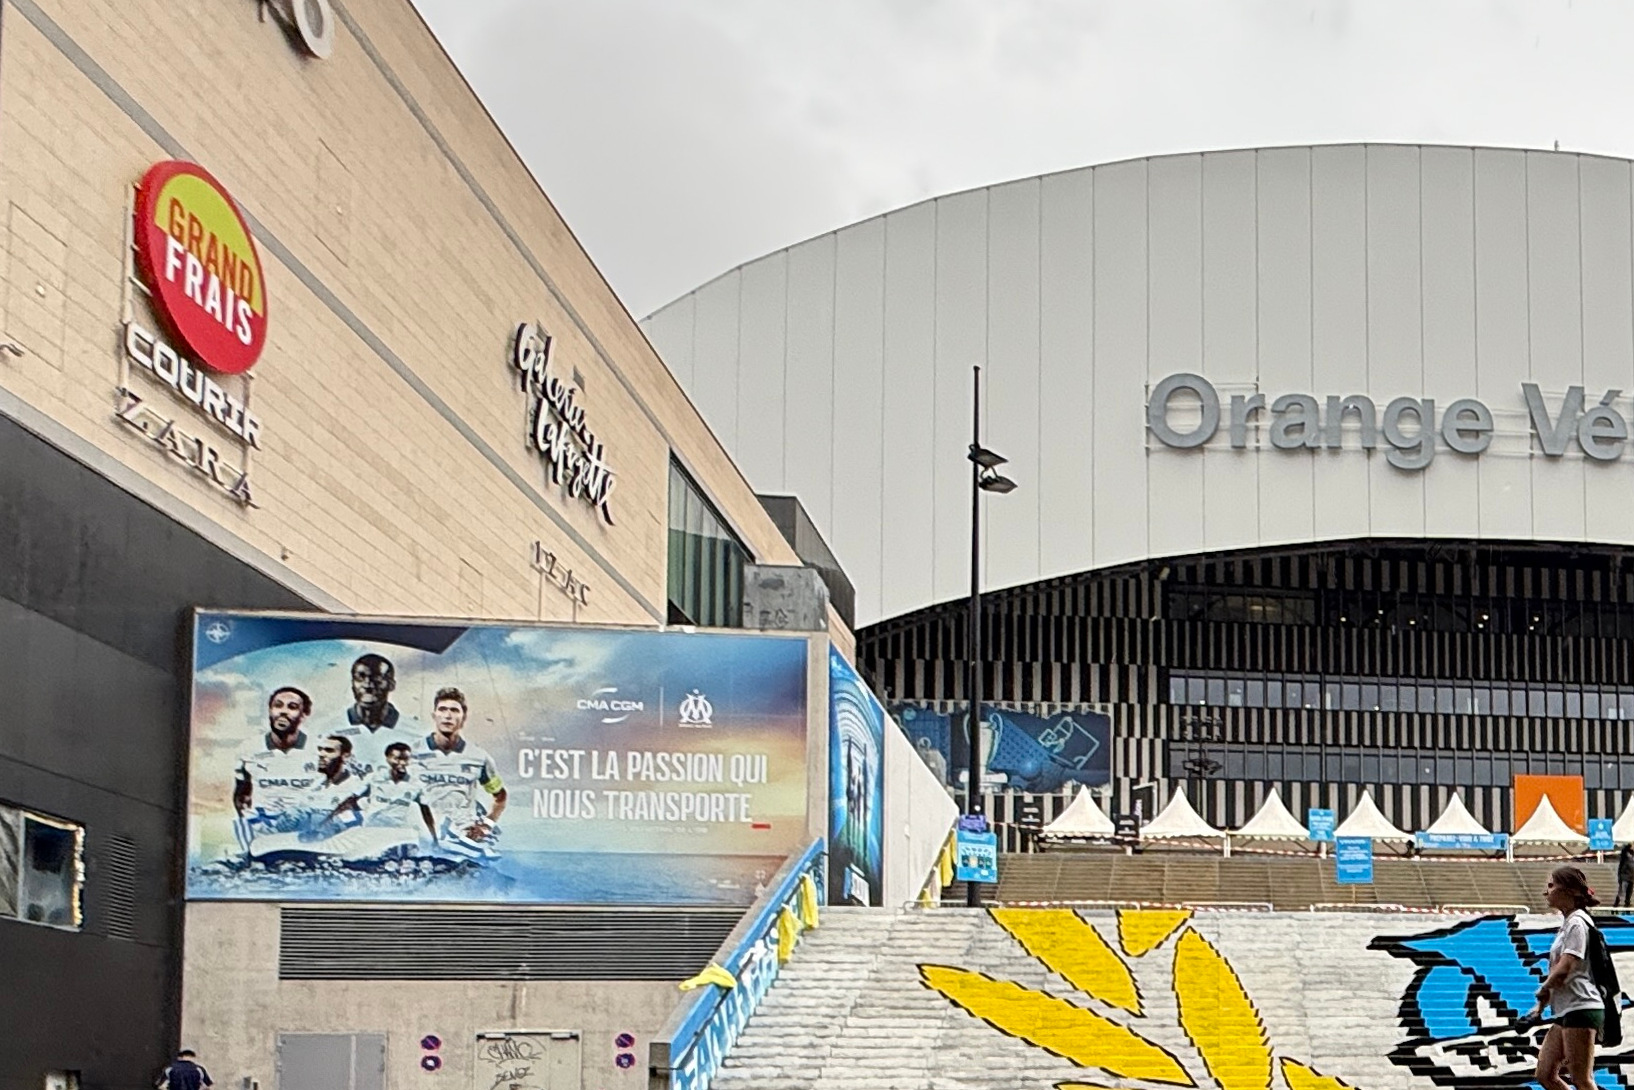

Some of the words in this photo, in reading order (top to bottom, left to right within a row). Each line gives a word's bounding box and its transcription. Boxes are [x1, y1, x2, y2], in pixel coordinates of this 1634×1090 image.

[164, 235, 253, 346] FRAIS
[168, 196, 254, 302] GRAND
[126, 322, 262, 451] COURIR
[1148, 372, 1494, 471] Orange
[115, 386, 260, 510] ZARA
[577, 699, 610, 711] CMA
[610, 699, 644, 711] CGM
[517, 748, 586, 780] C'EST
[591, 750, 621, 781] LA
[626, 751, 724, 784] PASSION
[729, 753, 768, 787] QUI
[532, 788, 596, 820] NOUS
[602, 790, 754, 823] TRANSPORTE
